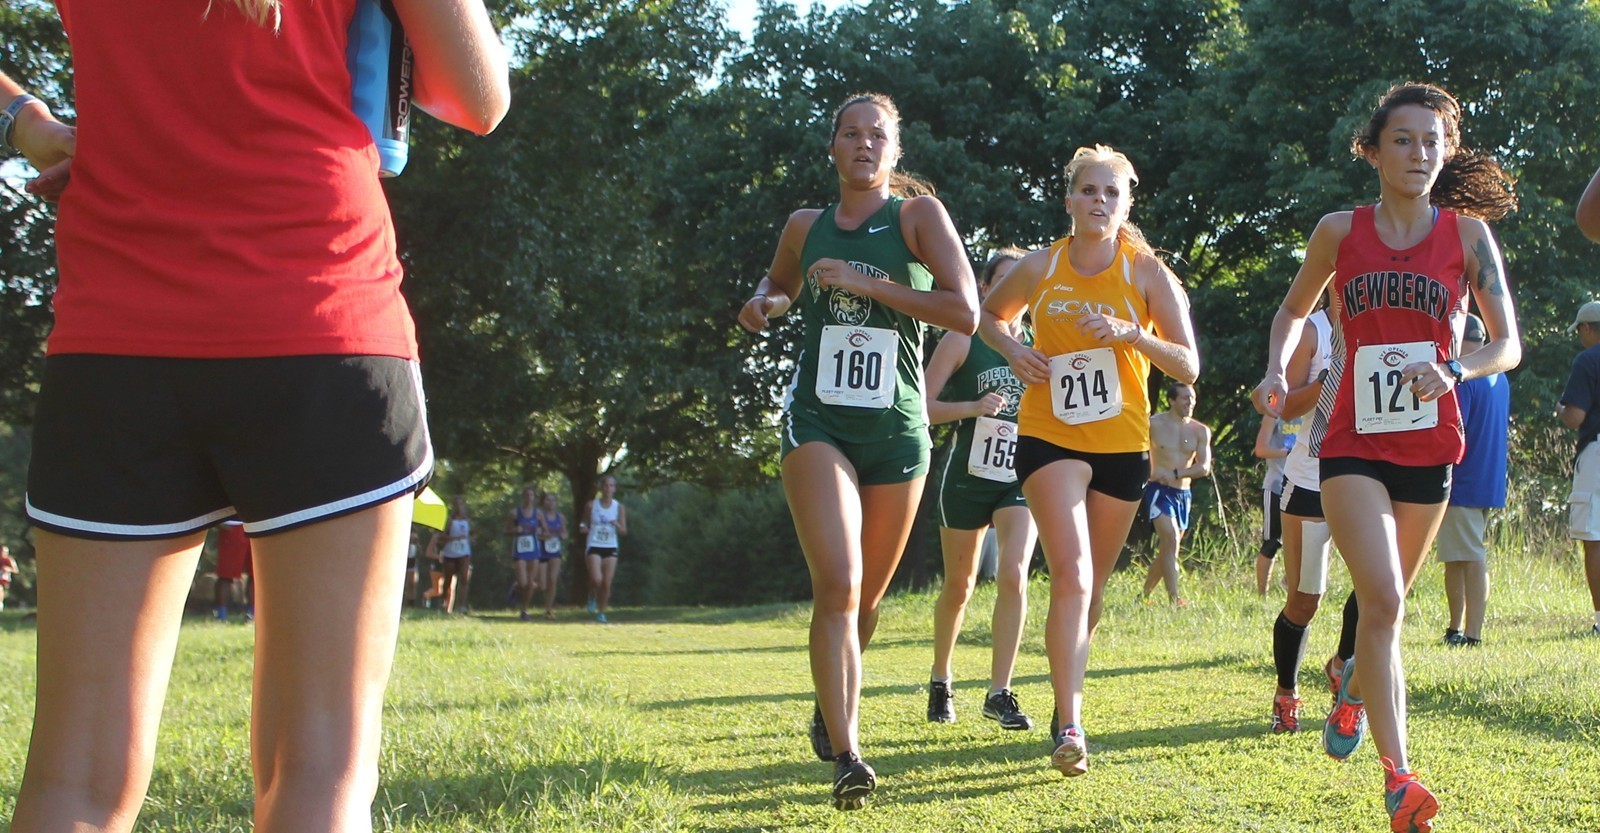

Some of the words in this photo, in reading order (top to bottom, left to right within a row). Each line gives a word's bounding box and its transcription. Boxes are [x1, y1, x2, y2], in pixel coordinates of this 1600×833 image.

[1046, 299, 1117, 317] SCAD
[1342, 271, 1449, 322] NEWBERRY
[833, 349, 882, 391] 160
[1387, 346, 1409, 358] OPENER
[1060, 369, 1109, 410] 214
[983, 436, 1017, 472] 155
